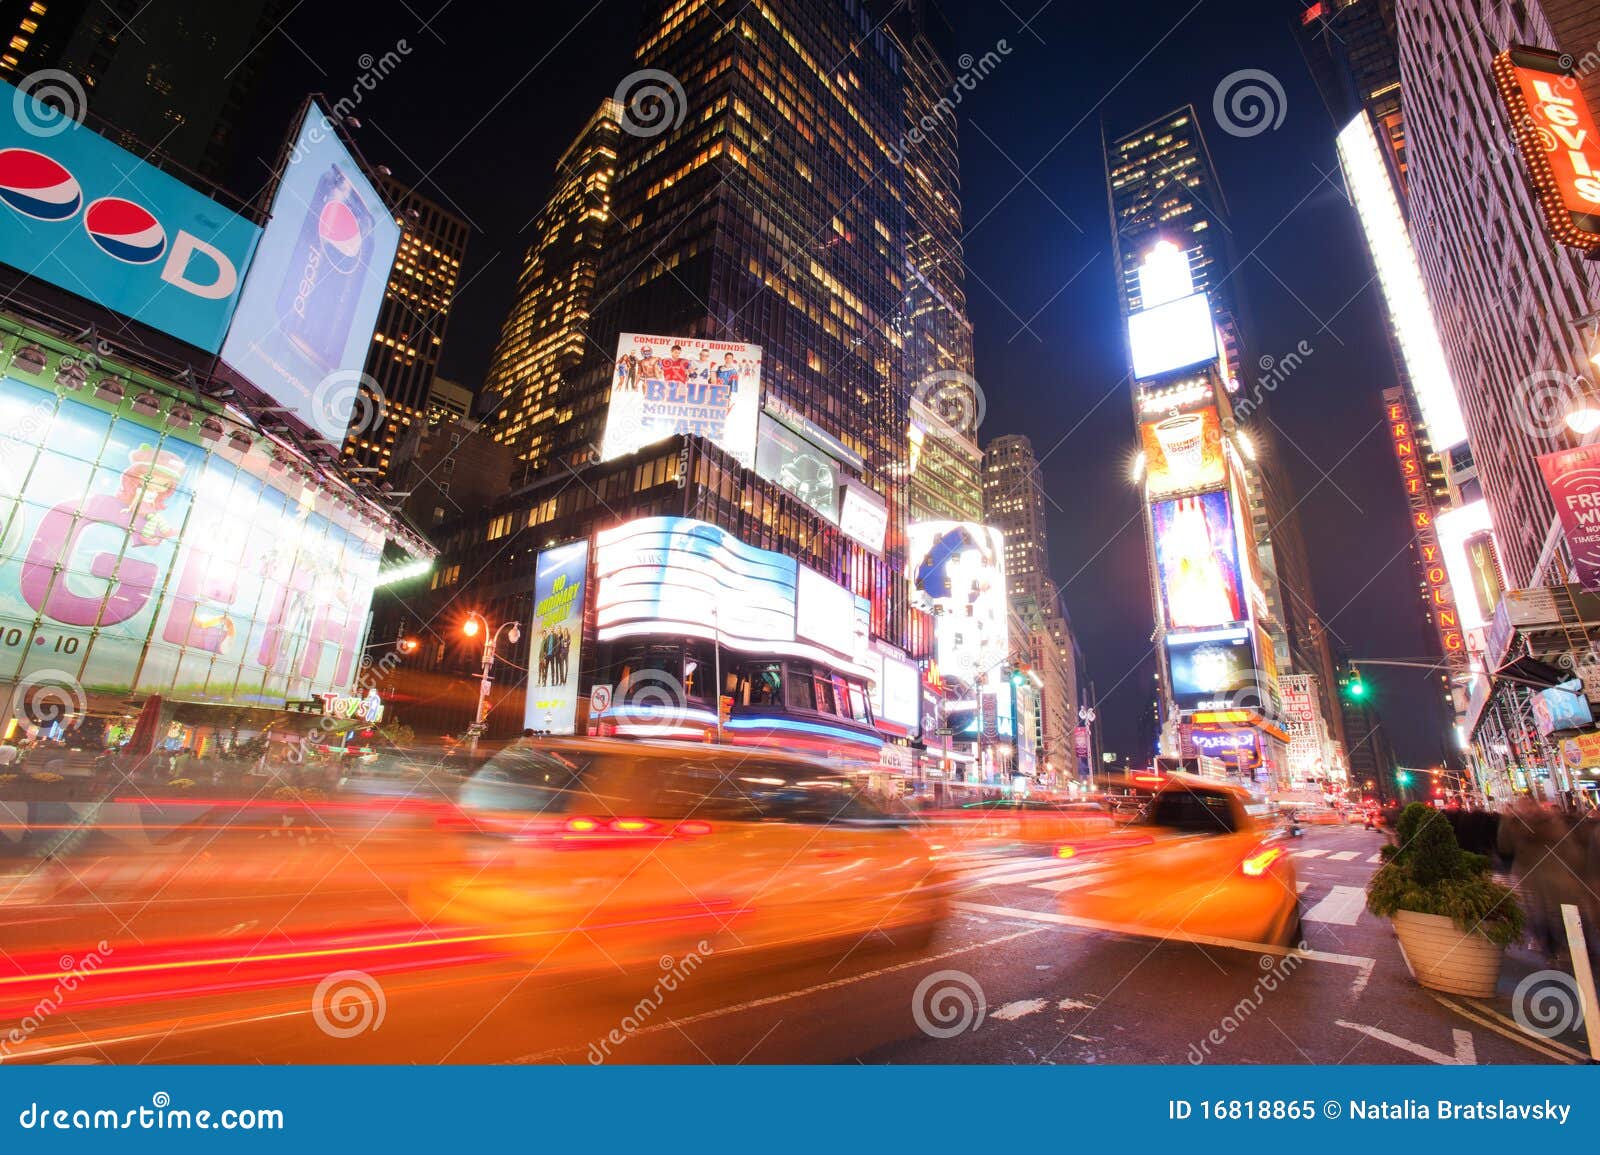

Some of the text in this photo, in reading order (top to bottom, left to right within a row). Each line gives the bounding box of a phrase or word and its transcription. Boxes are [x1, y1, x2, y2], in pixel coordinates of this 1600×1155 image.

[292, 246, 322, 320] pepsi
[633, 336, 671, 344] COMEDY
[645, 379, 730, 408] BLUE
[642, 403, 726, 419] MOUNTAIN
[1389, 405, 1420, 494] ERNST
[1416, 512, 1431, 527] &
[552, 574, 567, 594] NO
[54, 635, 79, 654] 10
[1293, 684, 1307, 692] NY
[1197, 701, 1233, 709] SONY
[1286, 721, 1301, 730] EST
